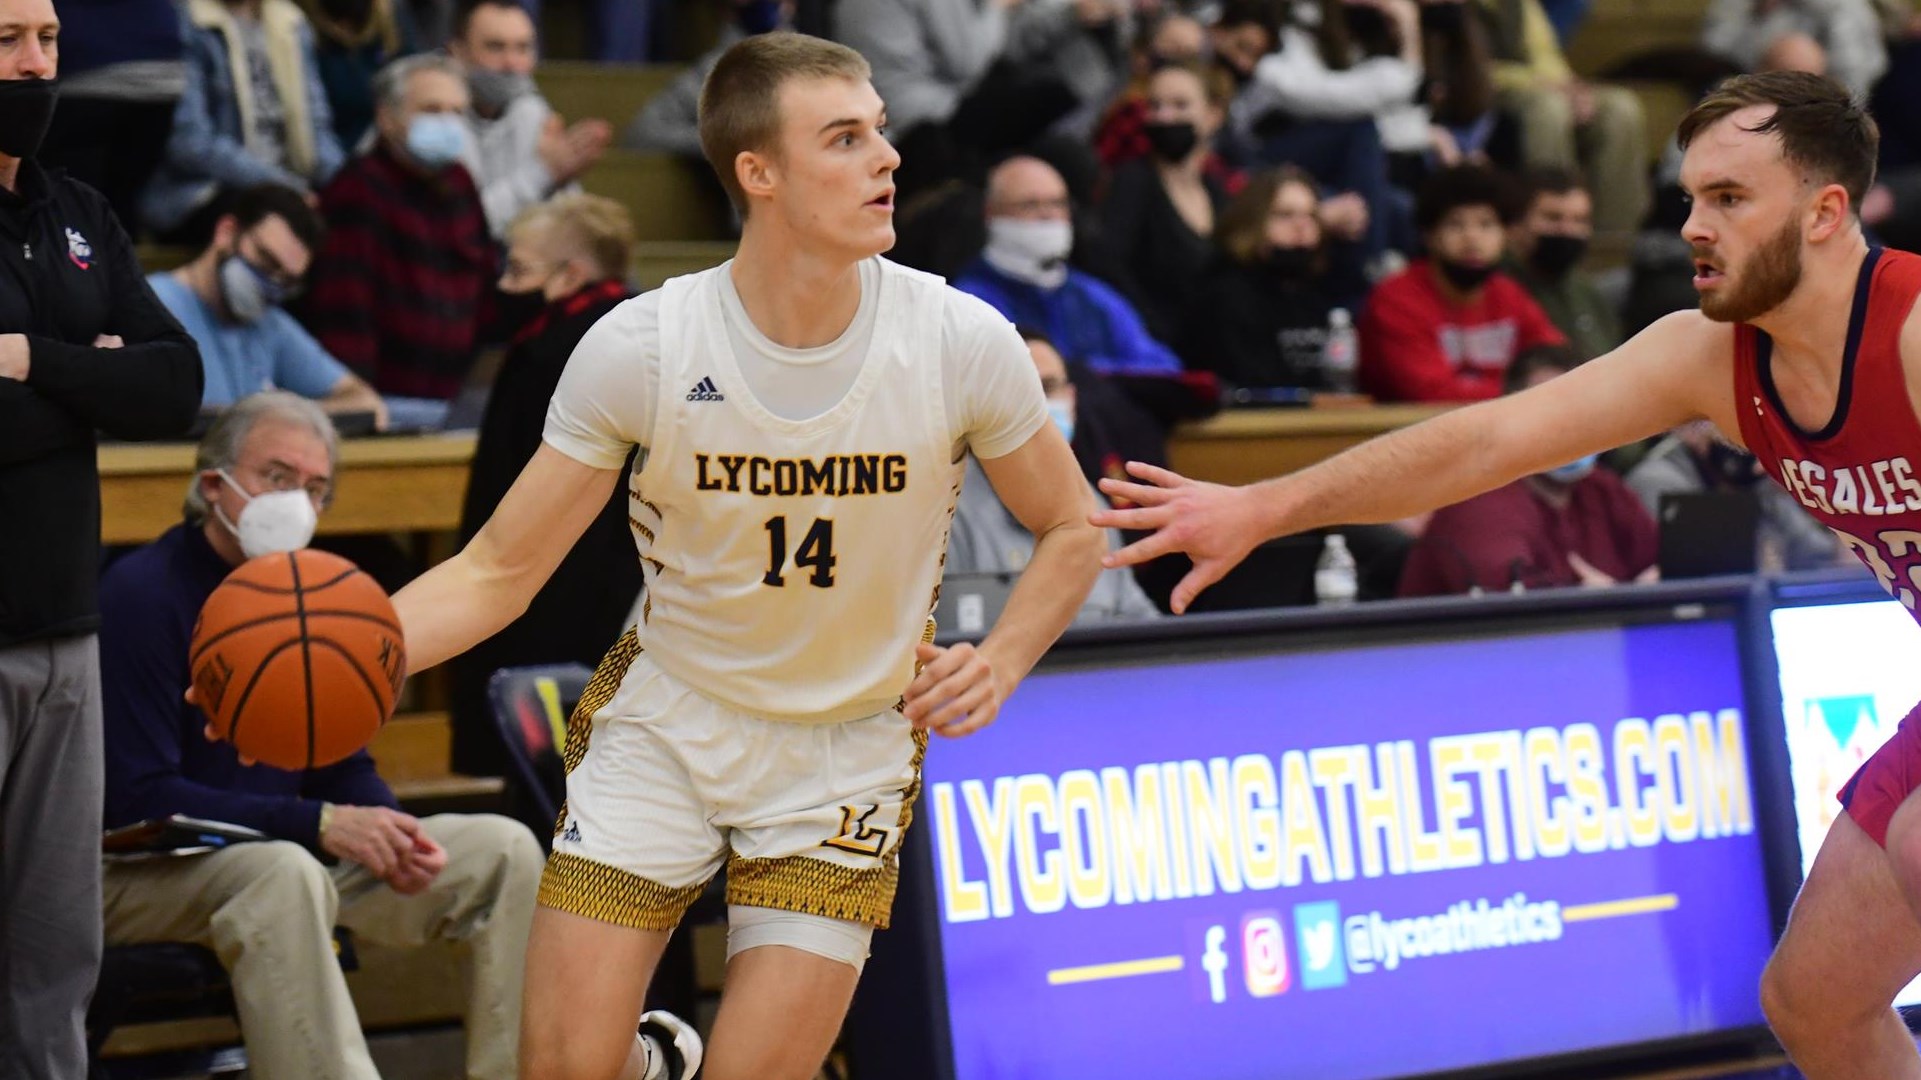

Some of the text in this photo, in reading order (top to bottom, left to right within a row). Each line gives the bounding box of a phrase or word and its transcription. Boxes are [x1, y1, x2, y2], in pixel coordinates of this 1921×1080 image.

[686, 391, 725, 402] adidas
[695, 453, 908, 497] LYCOMING
[762, 516, 837, 589] 14
[932, 708, 1755, 924] LYCOMINGATHLETICS.COM
[1344, 891, 1563, 974] @lycoathletics
